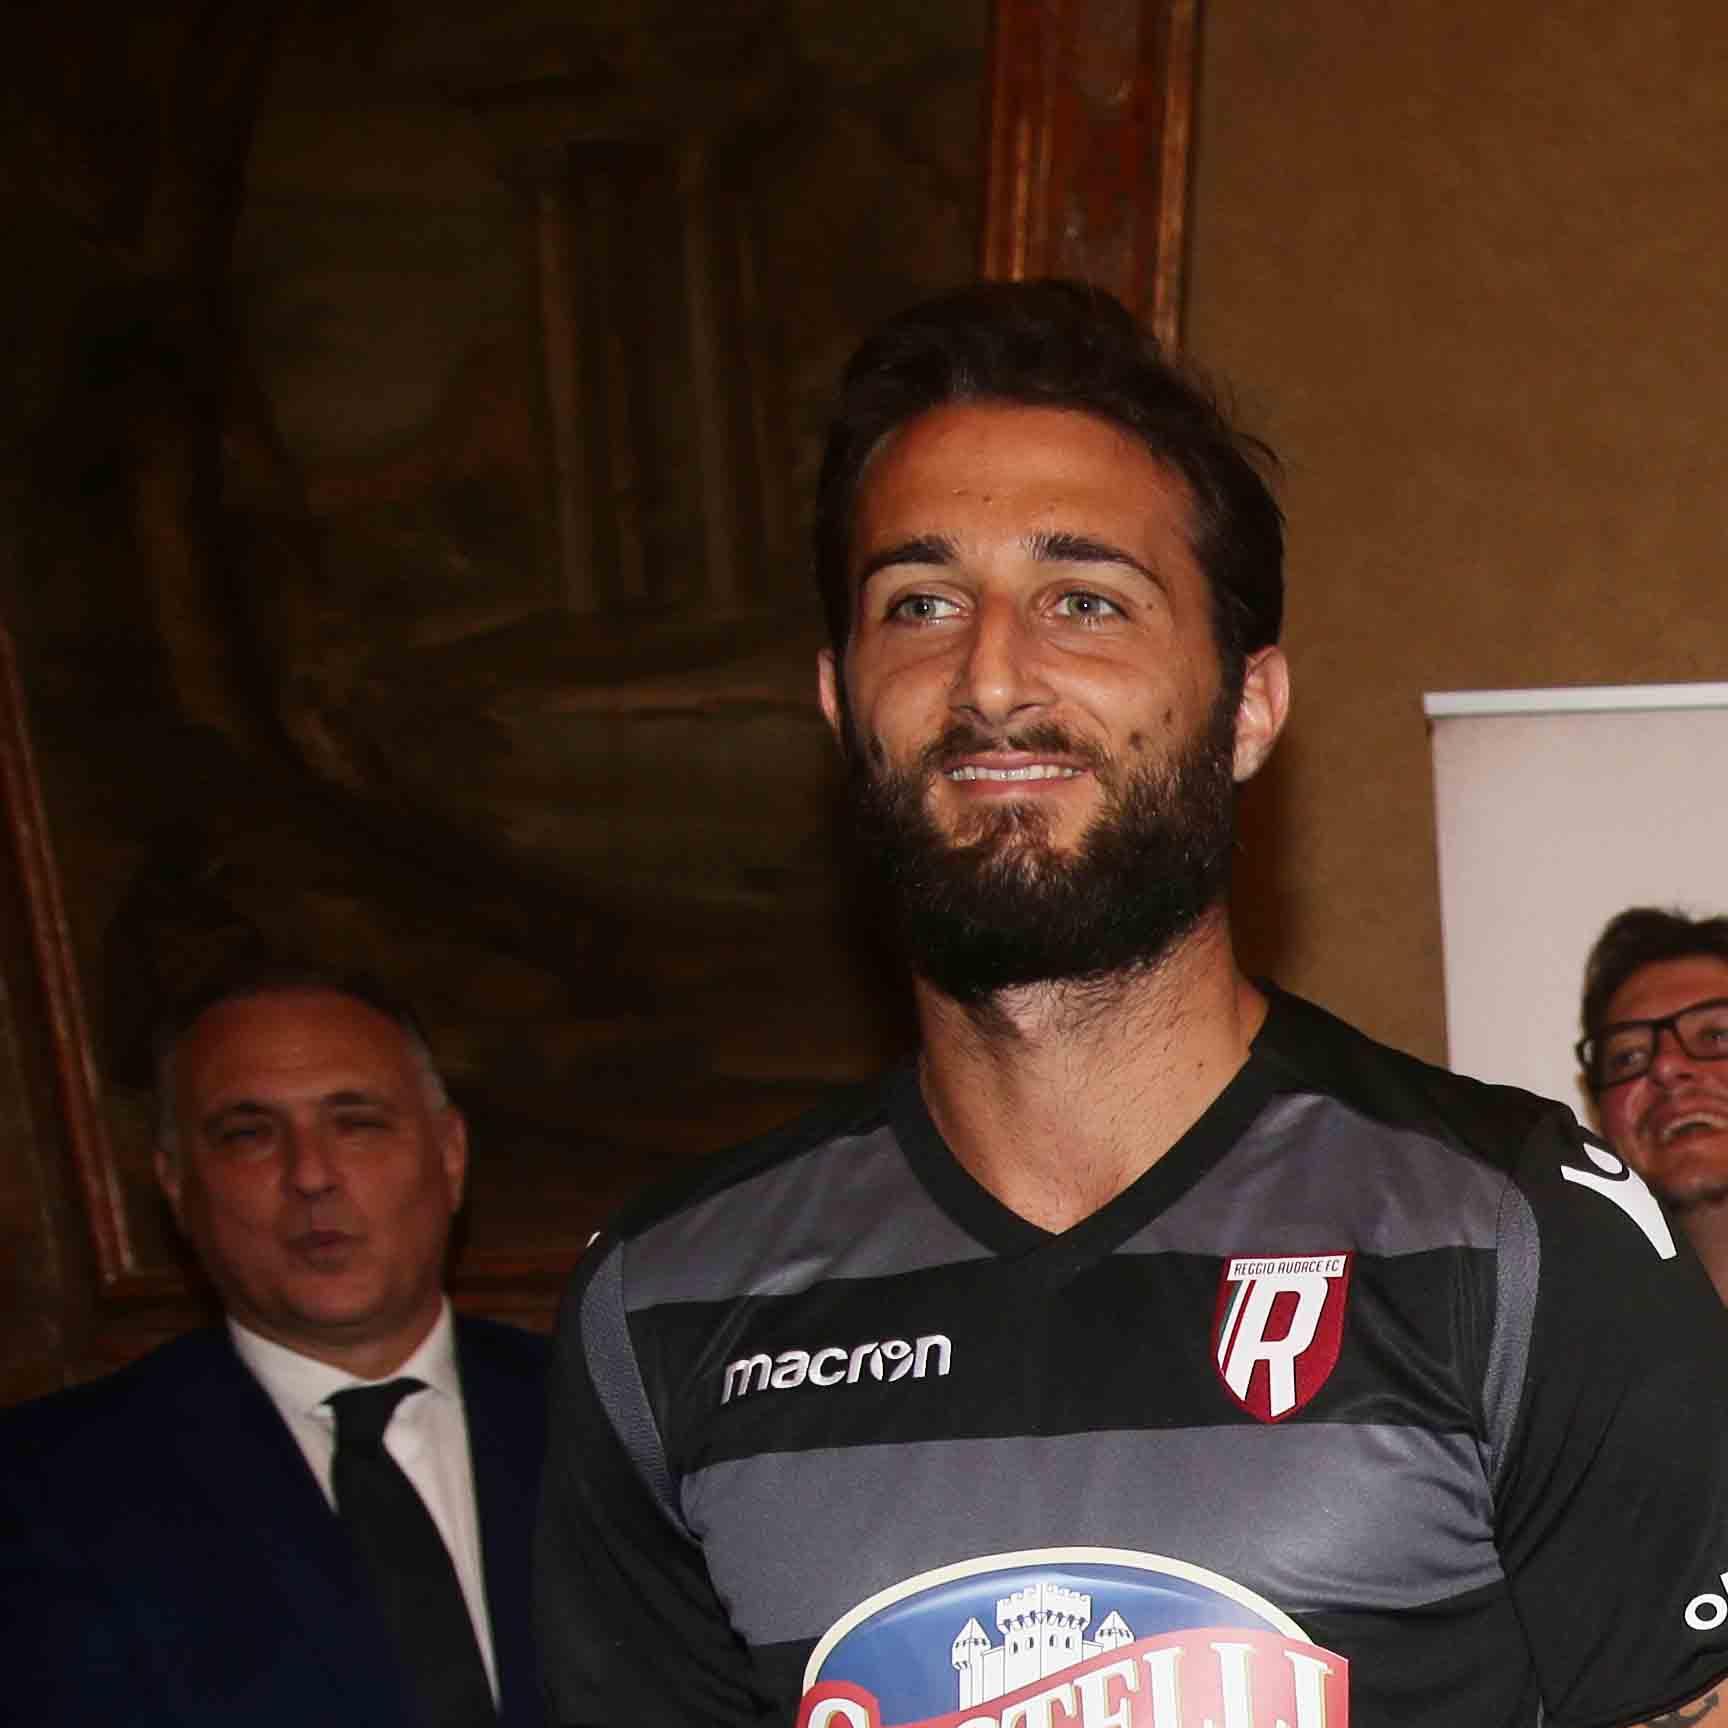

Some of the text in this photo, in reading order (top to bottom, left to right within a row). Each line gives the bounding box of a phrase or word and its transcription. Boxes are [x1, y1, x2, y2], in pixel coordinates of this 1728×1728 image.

[1233, 1258, 1340, 1277] REGGIO AUDACE FC
[720, 1334, 951, 1405] macron
[1225, 1279, 1329, 1417] R
